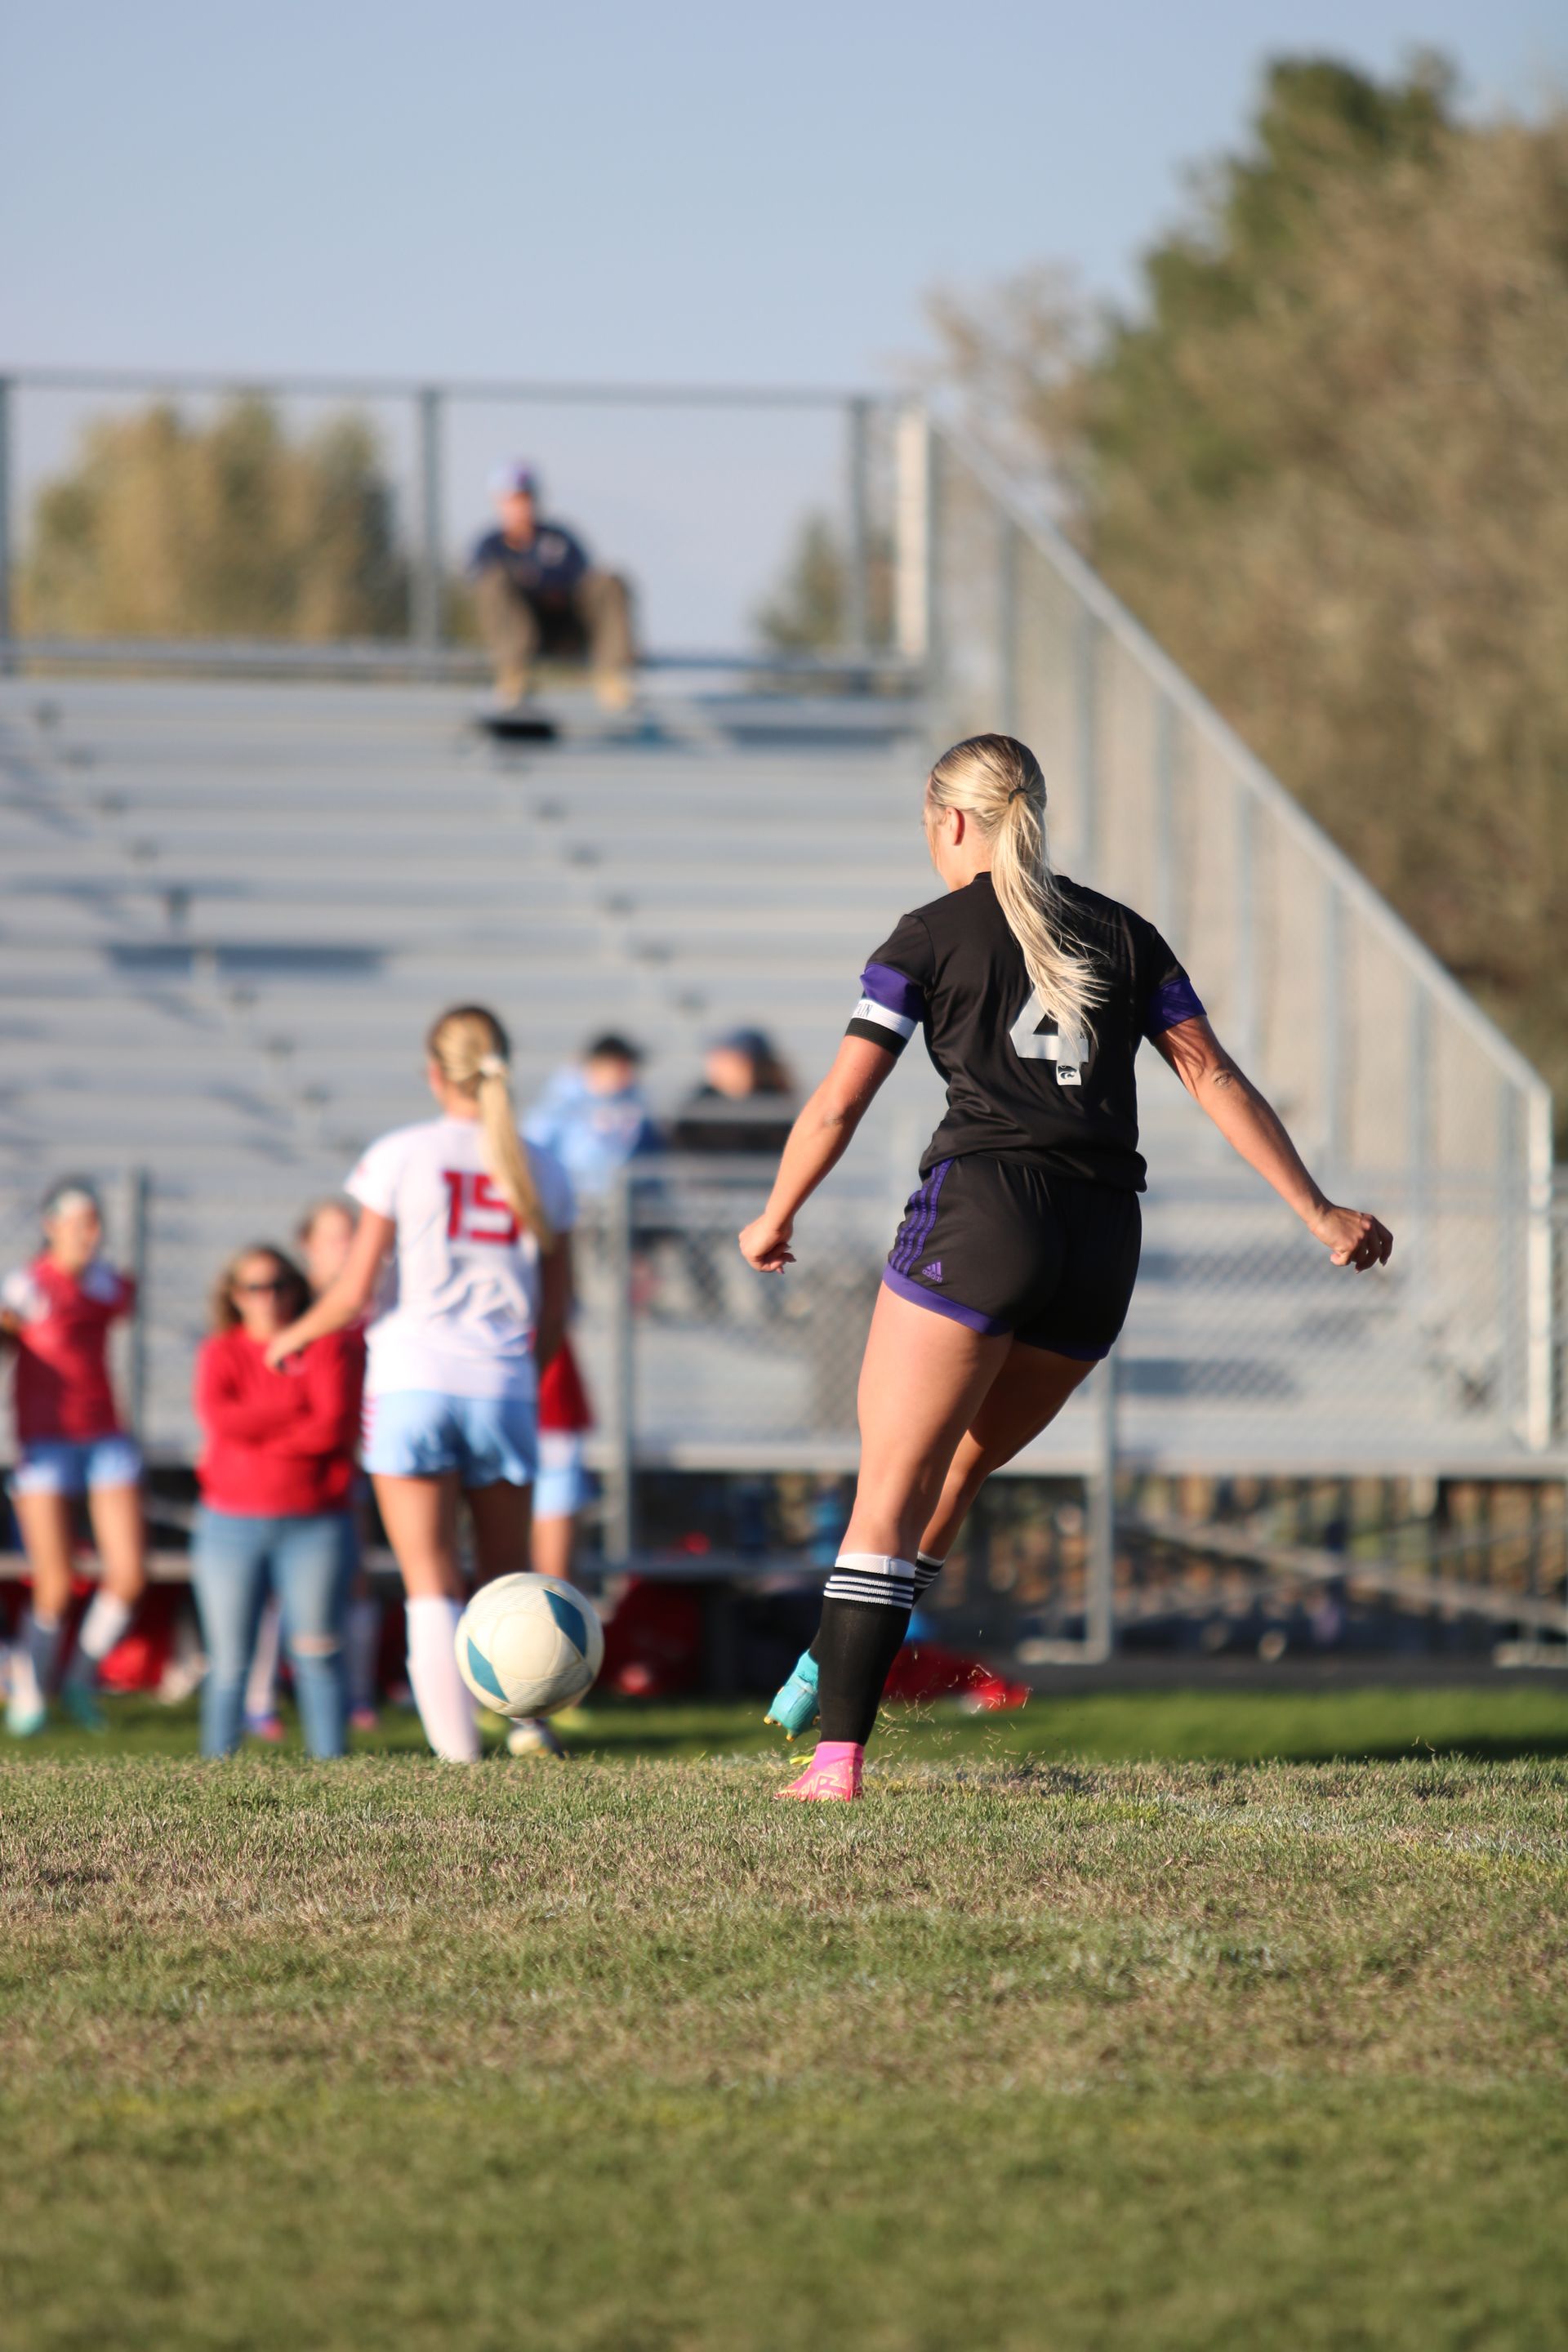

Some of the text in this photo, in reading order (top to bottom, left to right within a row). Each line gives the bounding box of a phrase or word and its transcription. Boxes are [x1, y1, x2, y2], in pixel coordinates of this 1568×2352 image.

[1009, 976, 1089, 1085] 4
[442, 1170, 519, 1245] 15
[922, 1269, 942, 1283] adidas
